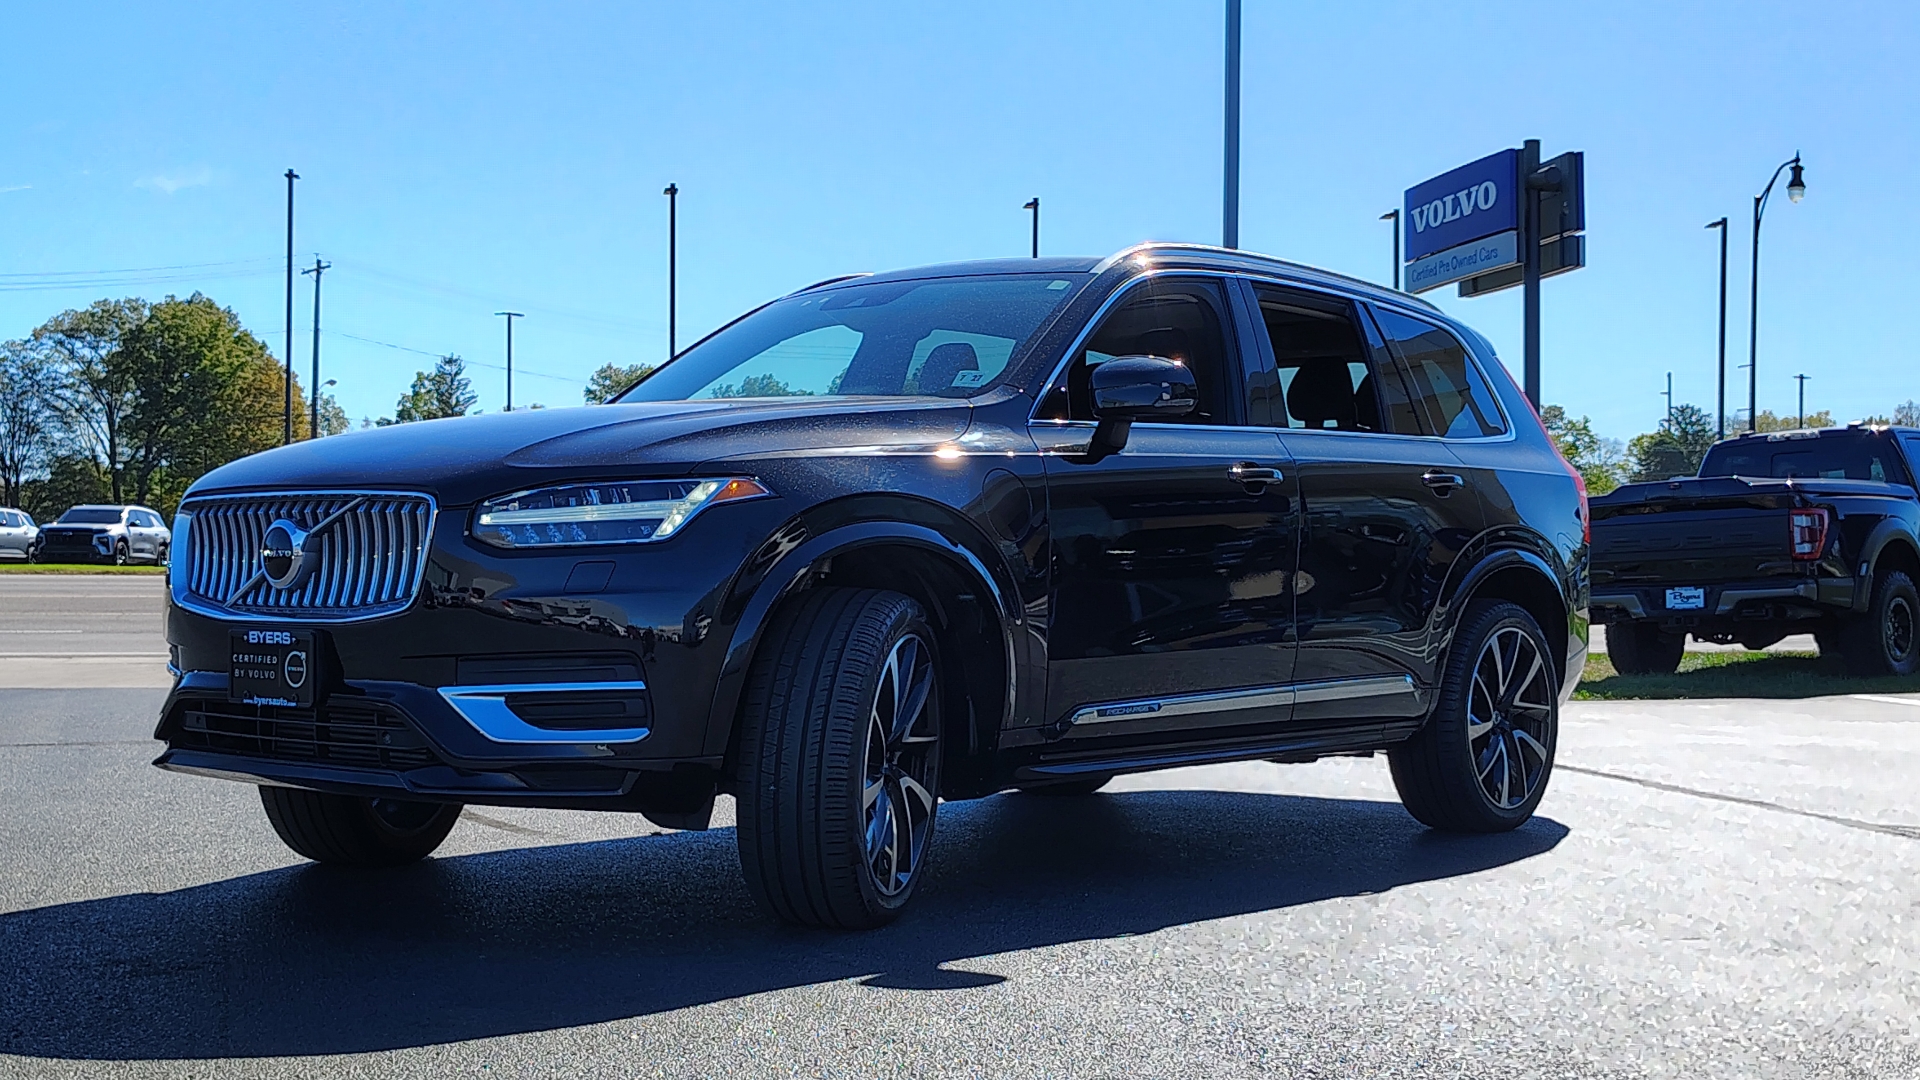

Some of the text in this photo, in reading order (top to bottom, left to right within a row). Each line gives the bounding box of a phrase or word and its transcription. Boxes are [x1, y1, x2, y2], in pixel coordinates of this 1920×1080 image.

[1410, 181, 1498, 234] VOLVO
[1411, 247, 1498, 283] Certified Pre Owned Cars
[248, 631, 291, 645] BYERS
[232, 653, 278, 664] CERTIFIED
[234, 668, 276, 679] BY VOLVO
